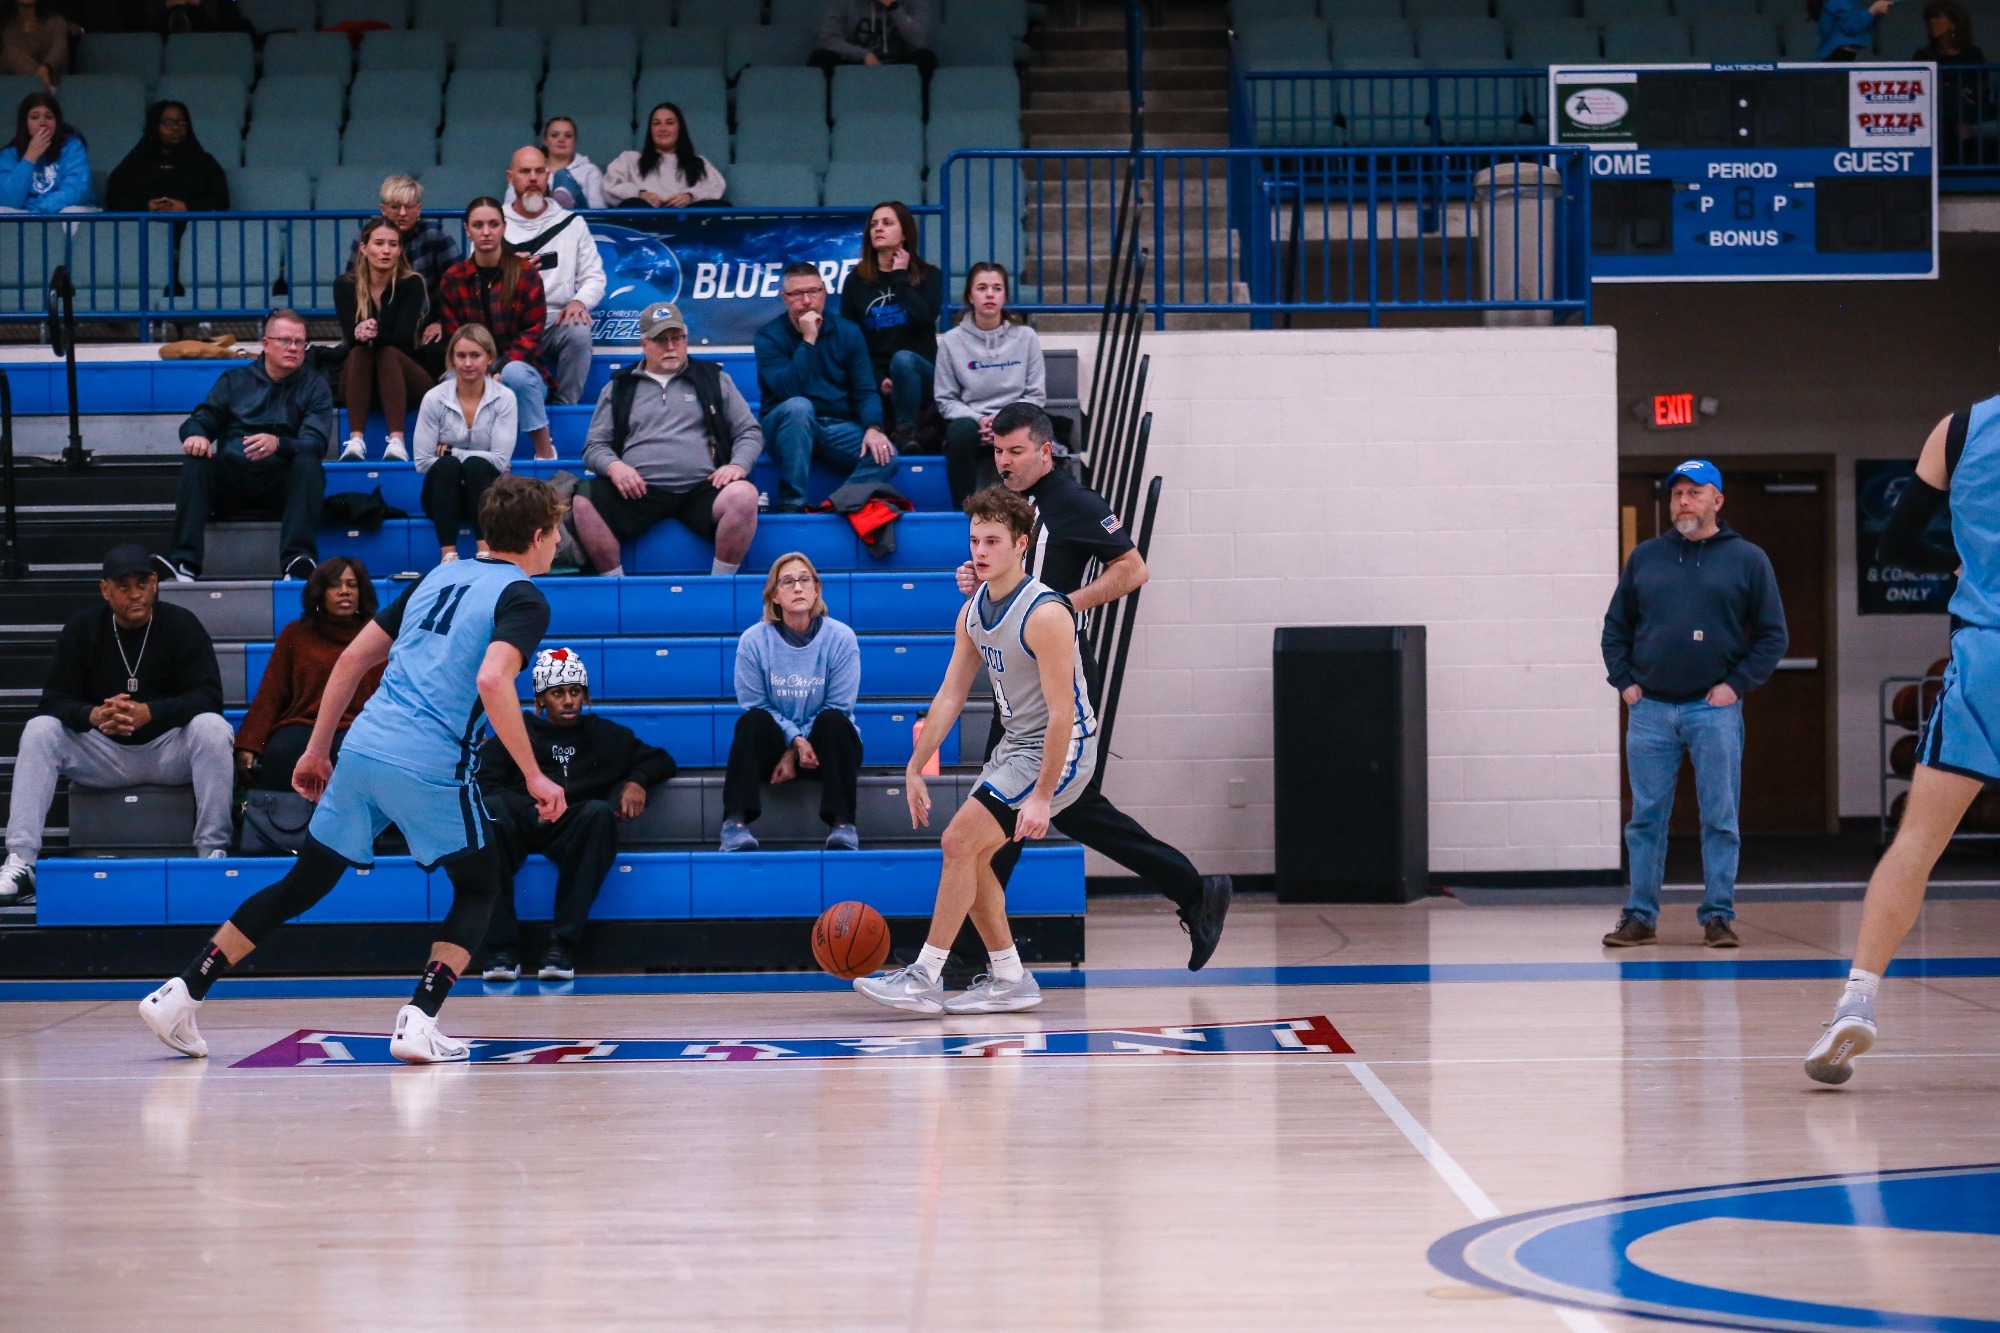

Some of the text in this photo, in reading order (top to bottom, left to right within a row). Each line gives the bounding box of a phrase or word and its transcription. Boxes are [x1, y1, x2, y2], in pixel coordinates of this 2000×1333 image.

[1858, 81, 1924, 95] PIZZA
[1858, 113, 1924, 128] PIZZA
[1590, 154, 1651, 175] OME
[1834, 152, 1914, 172] GUEST
[1708, 163, 1777, 178] PERIOD
[1701, 196, 1714, 213] P
[1774, 196, 1787, 212] P
[1710, 231, 1778, 246] BONUS
[693, 262, 783, 299] BLUE
[591, 319, 642, 339] LAZE
[968, 361, 1021, 370] Champion
[1654, 394, 1693, 425] EXIT
[1886, 587, 1931, 601] ONLY
[419, 584, 471, 636] 11
[552, 745, 575, 757] GOOD
